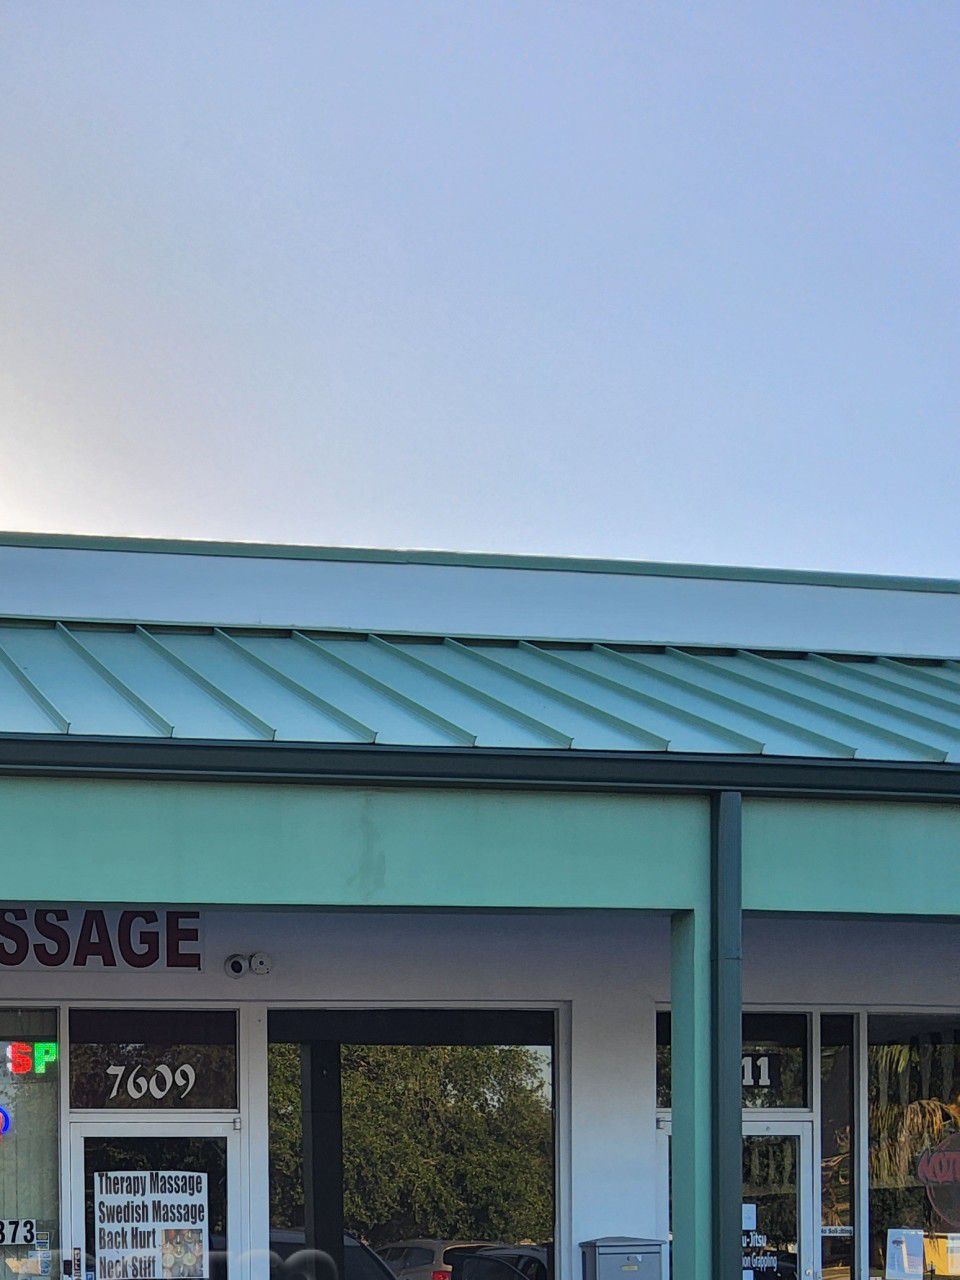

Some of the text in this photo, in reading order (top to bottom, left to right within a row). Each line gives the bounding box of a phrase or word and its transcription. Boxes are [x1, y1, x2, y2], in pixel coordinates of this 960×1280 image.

[106, 1062, 196, 1100] 7609
[98, 1171, 203, 1197] Therapy Massage
[98, 1200, 205, 1225] Swedish Massage
[98, 1227, 157, 1250] Back Hurt
[99, 1255, 156, 1279] Neck Stiff
